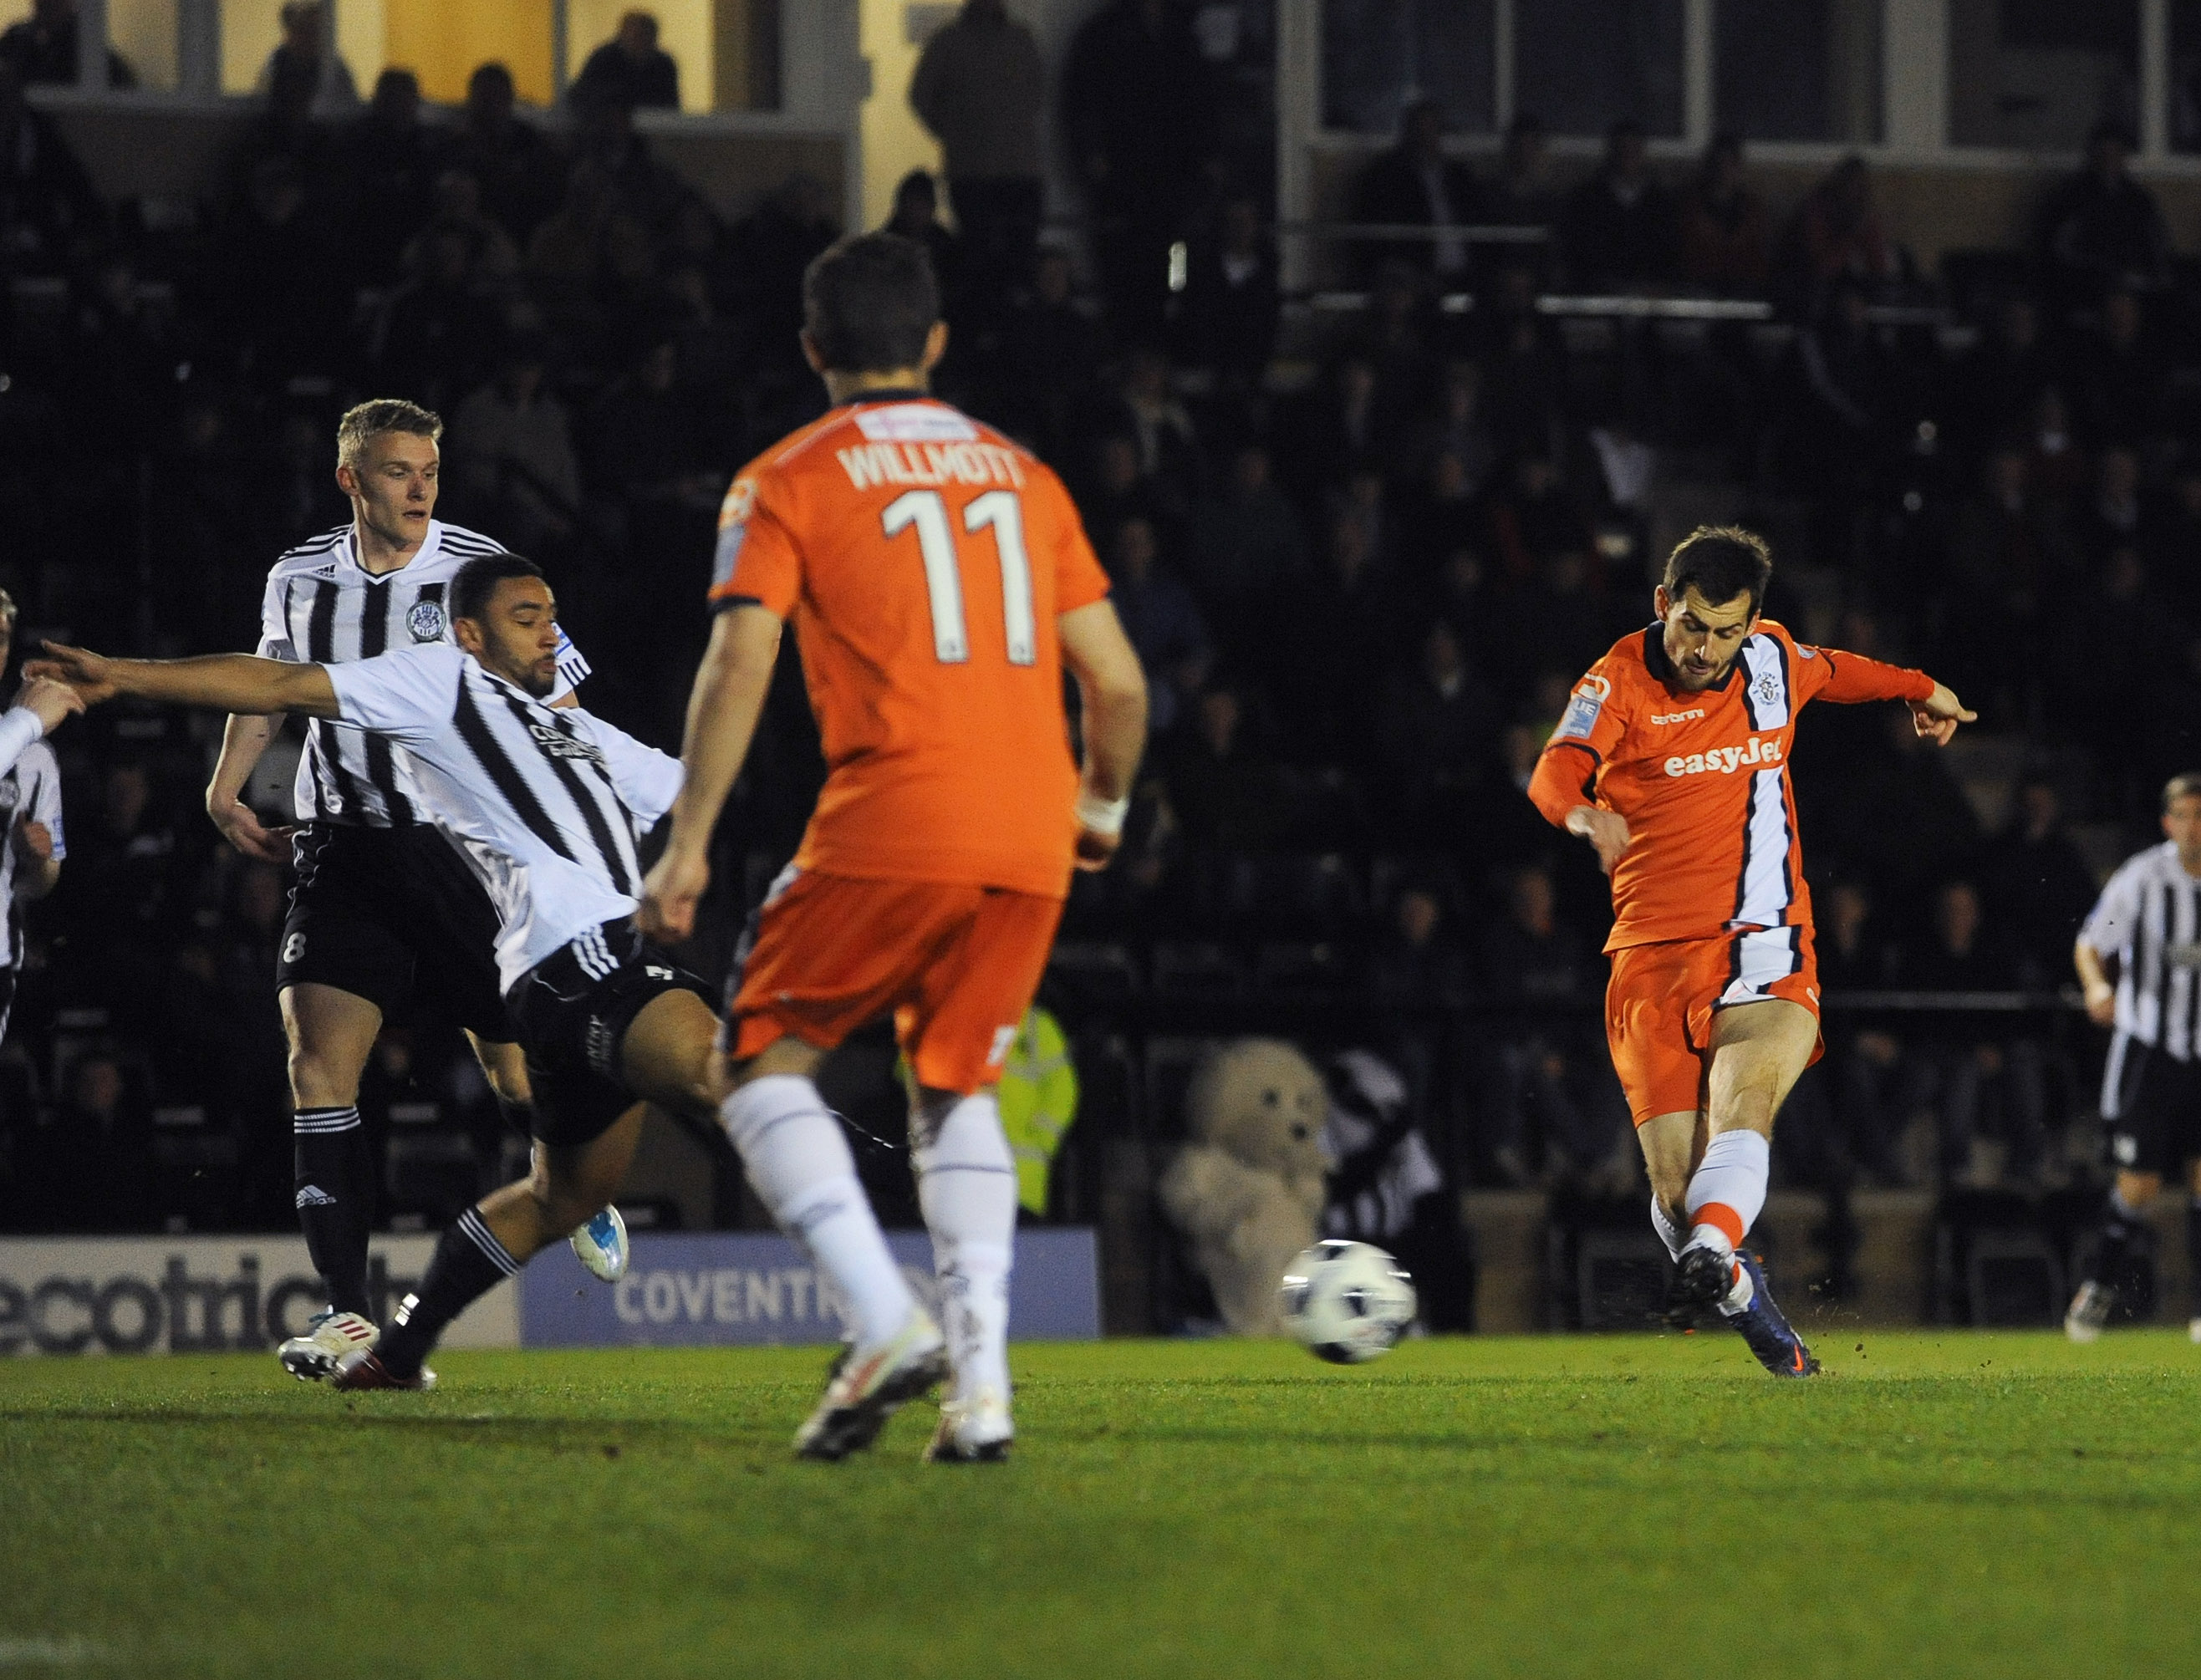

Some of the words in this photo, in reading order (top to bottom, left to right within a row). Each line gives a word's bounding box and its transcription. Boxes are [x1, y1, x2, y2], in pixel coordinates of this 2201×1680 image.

[837, 442, 1027, 491] WILLMOTT
[881, 488, 1036, 666] 11
[1663, 736, 1783, 777] easyJet
[283, 932, 307, 963] 8
[614, 1267, 856, 1324] COVENTR
